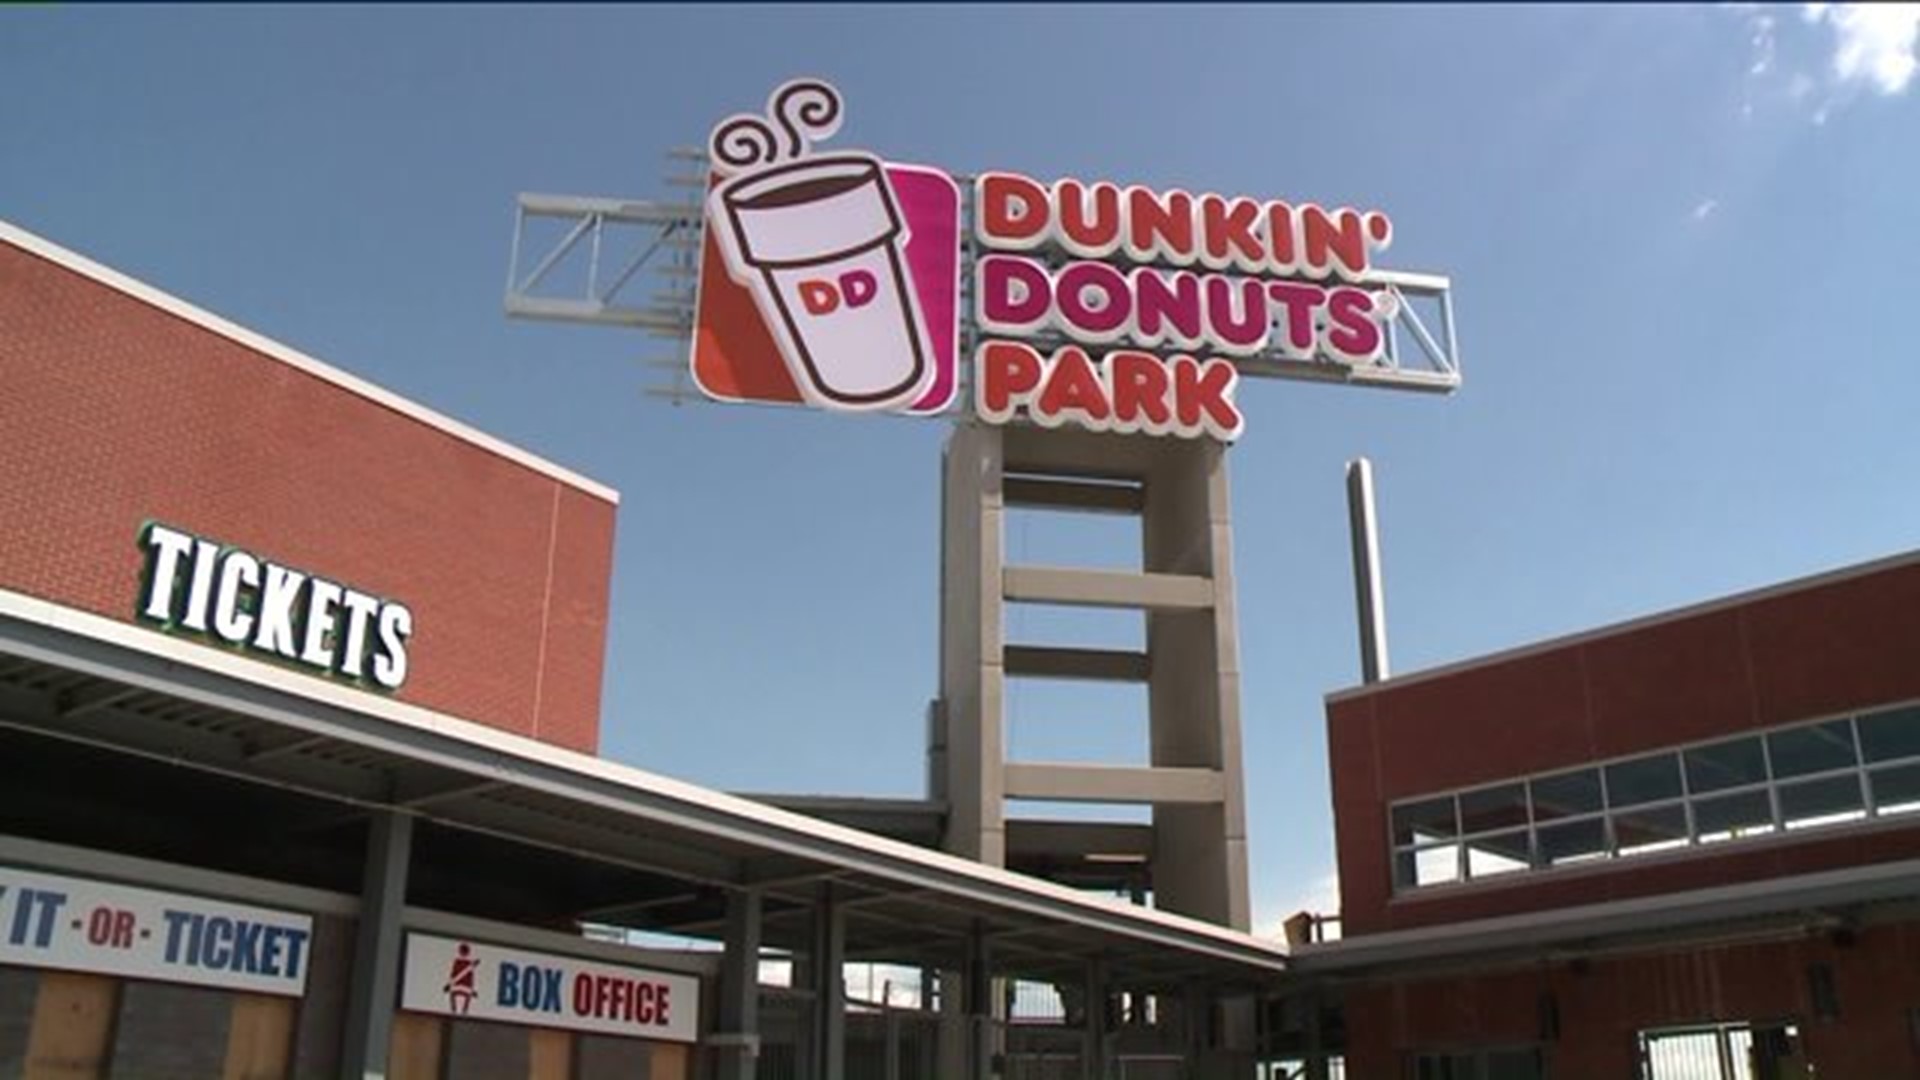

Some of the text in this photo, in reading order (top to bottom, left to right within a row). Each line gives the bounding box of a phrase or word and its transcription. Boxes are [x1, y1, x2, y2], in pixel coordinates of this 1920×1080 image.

[983, 174, 1388, 274] DUNKIN'
[797, 269, 878, 316] DD
[983, 258, 1380, 356] DONUTS
[984, 344, 1239, 431] PARK
[145, 525, 412, 688] TICKETS
[9, 887, 67, 948] IT
[163, 909, 309, 979] TICKET
[497, 962, 671, 1027] BOX OFFICE
